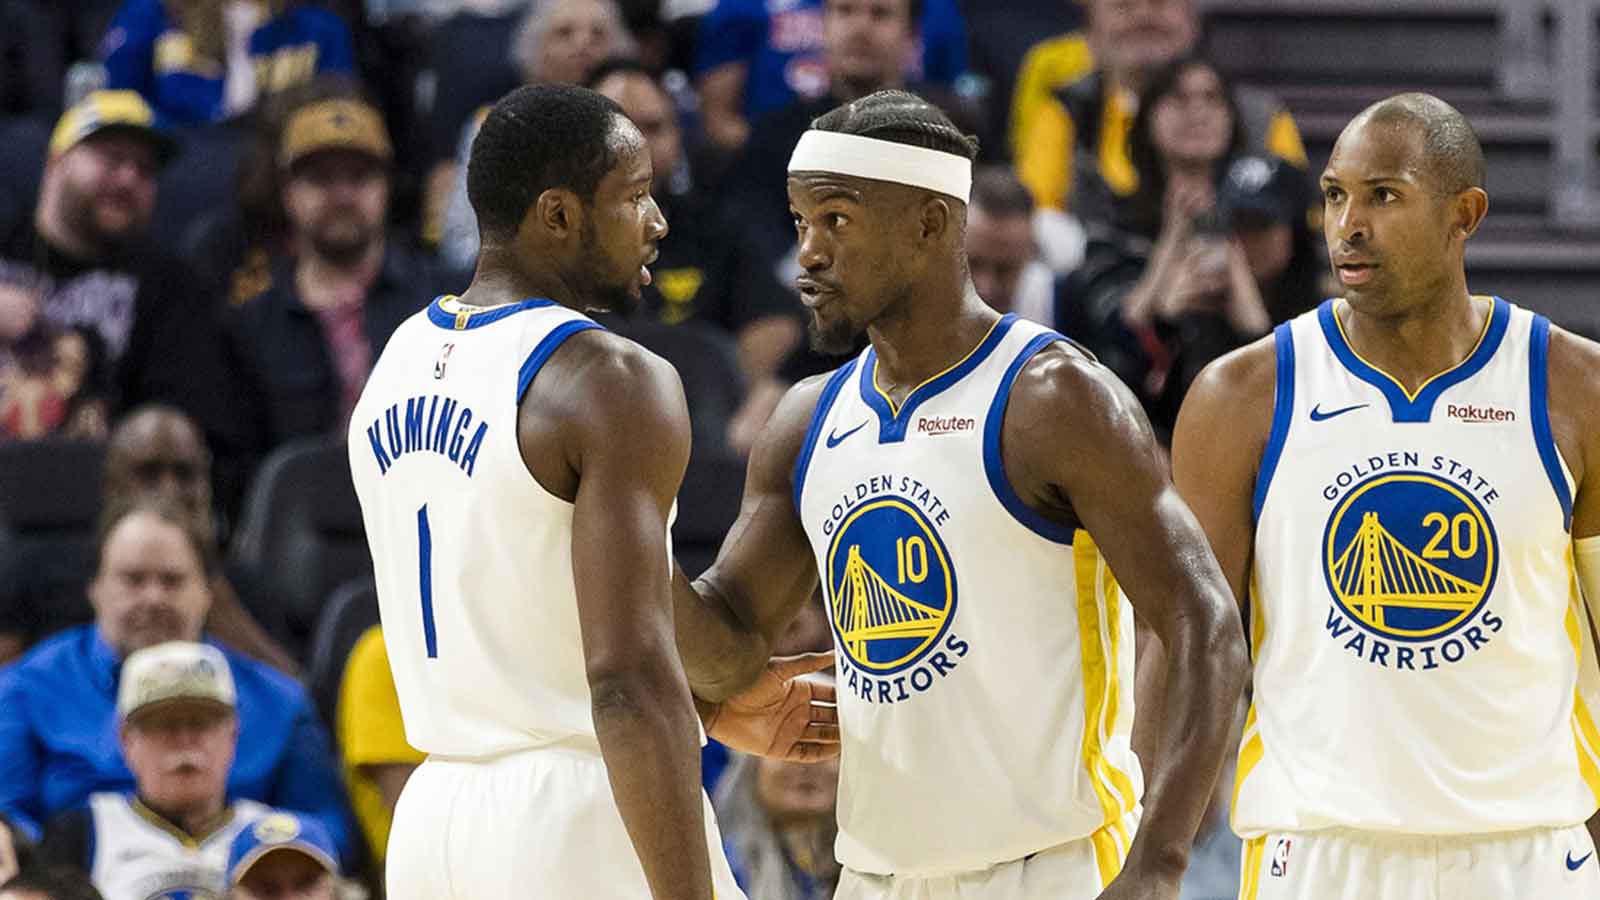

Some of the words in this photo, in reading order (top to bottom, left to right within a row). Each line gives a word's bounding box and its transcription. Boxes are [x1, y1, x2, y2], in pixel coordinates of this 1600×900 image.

[367, 395, 488, 477] KUMINGA
[917, 416, 975, 435] Rakuten
[1447, 404, 1515, 422] Rakuten
[823, 474, 892, 536] GOLDEN
[899, 476, 950, 526] STATE
[1323, 452, 1418, 501] GOLDEN
[1431, 455, 1500, 505] STATE
[896, 535, 928, 584] 10
[1422, 512, 1478, 559] 20
[417, 502, 438, 658] 1
[1325, 606, 1503, 670] WARRIORS
